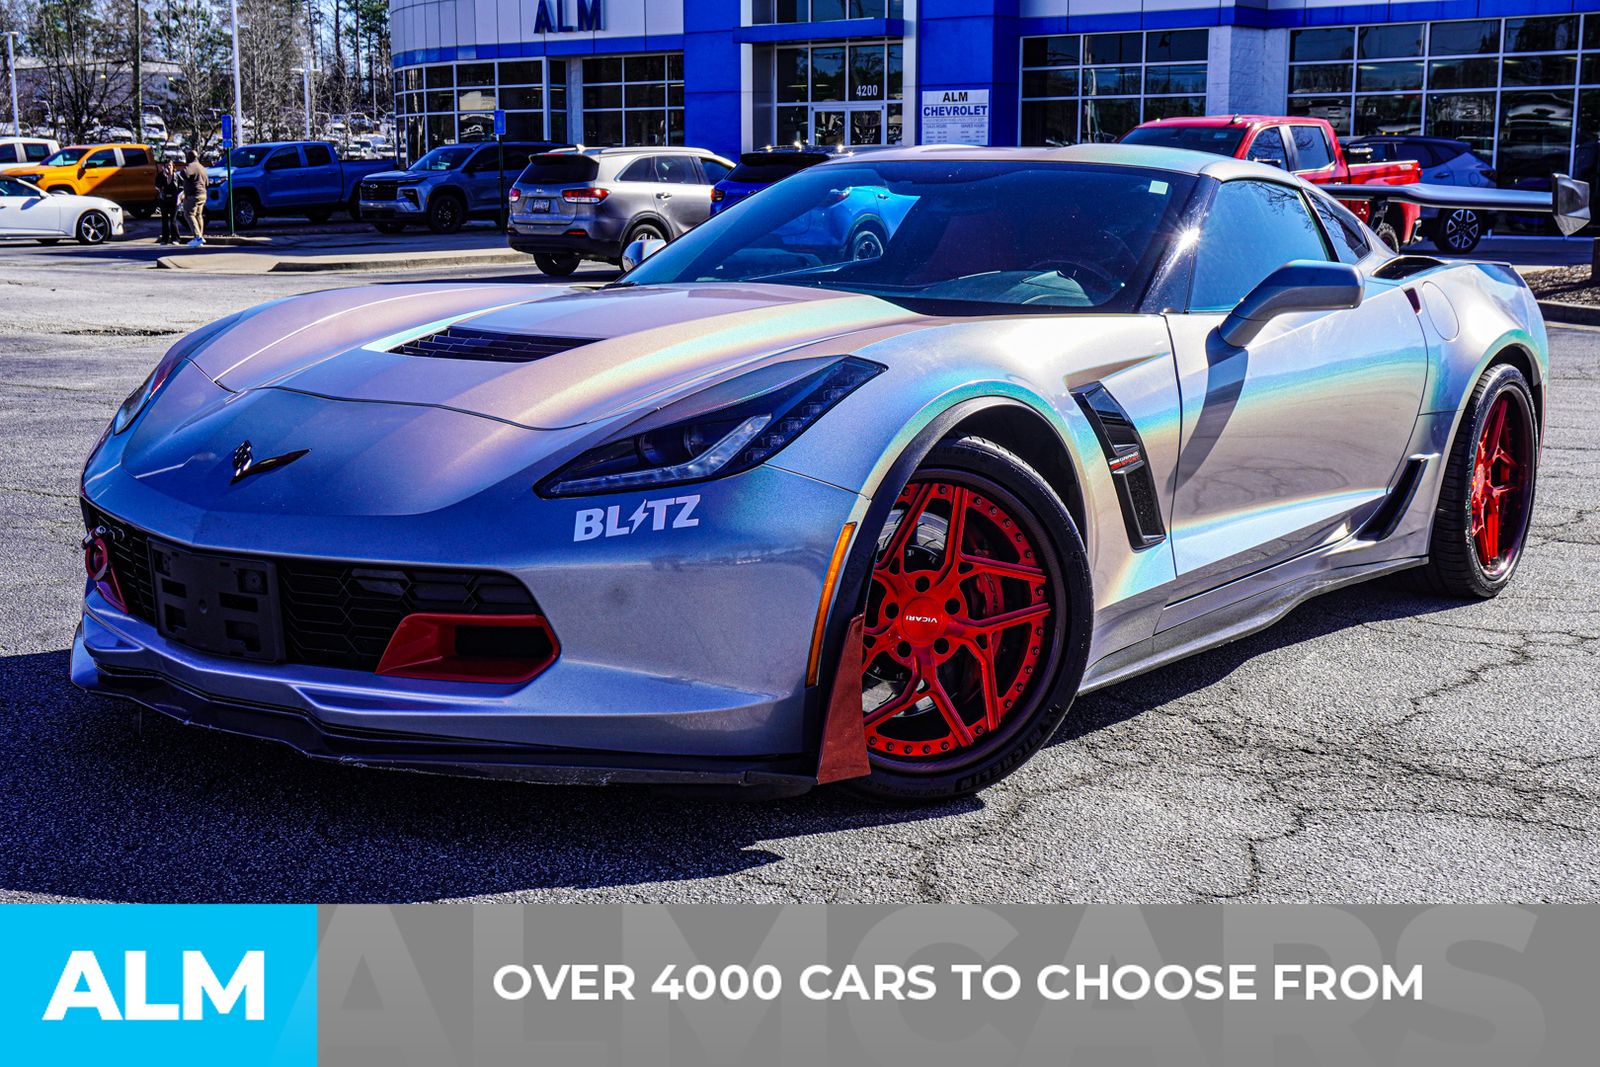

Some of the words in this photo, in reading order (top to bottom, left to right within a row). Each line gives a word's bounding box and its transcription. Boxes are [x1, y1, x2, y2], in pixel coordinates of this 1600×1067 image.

[533, 0, 605, 33] ALM
[856, 85, 878, 96] 4200
[943, 92, 968, 102] ALM
[923, 105, 988, 116] CHEVROLET
[905, 615, 938, 623] VICARI
